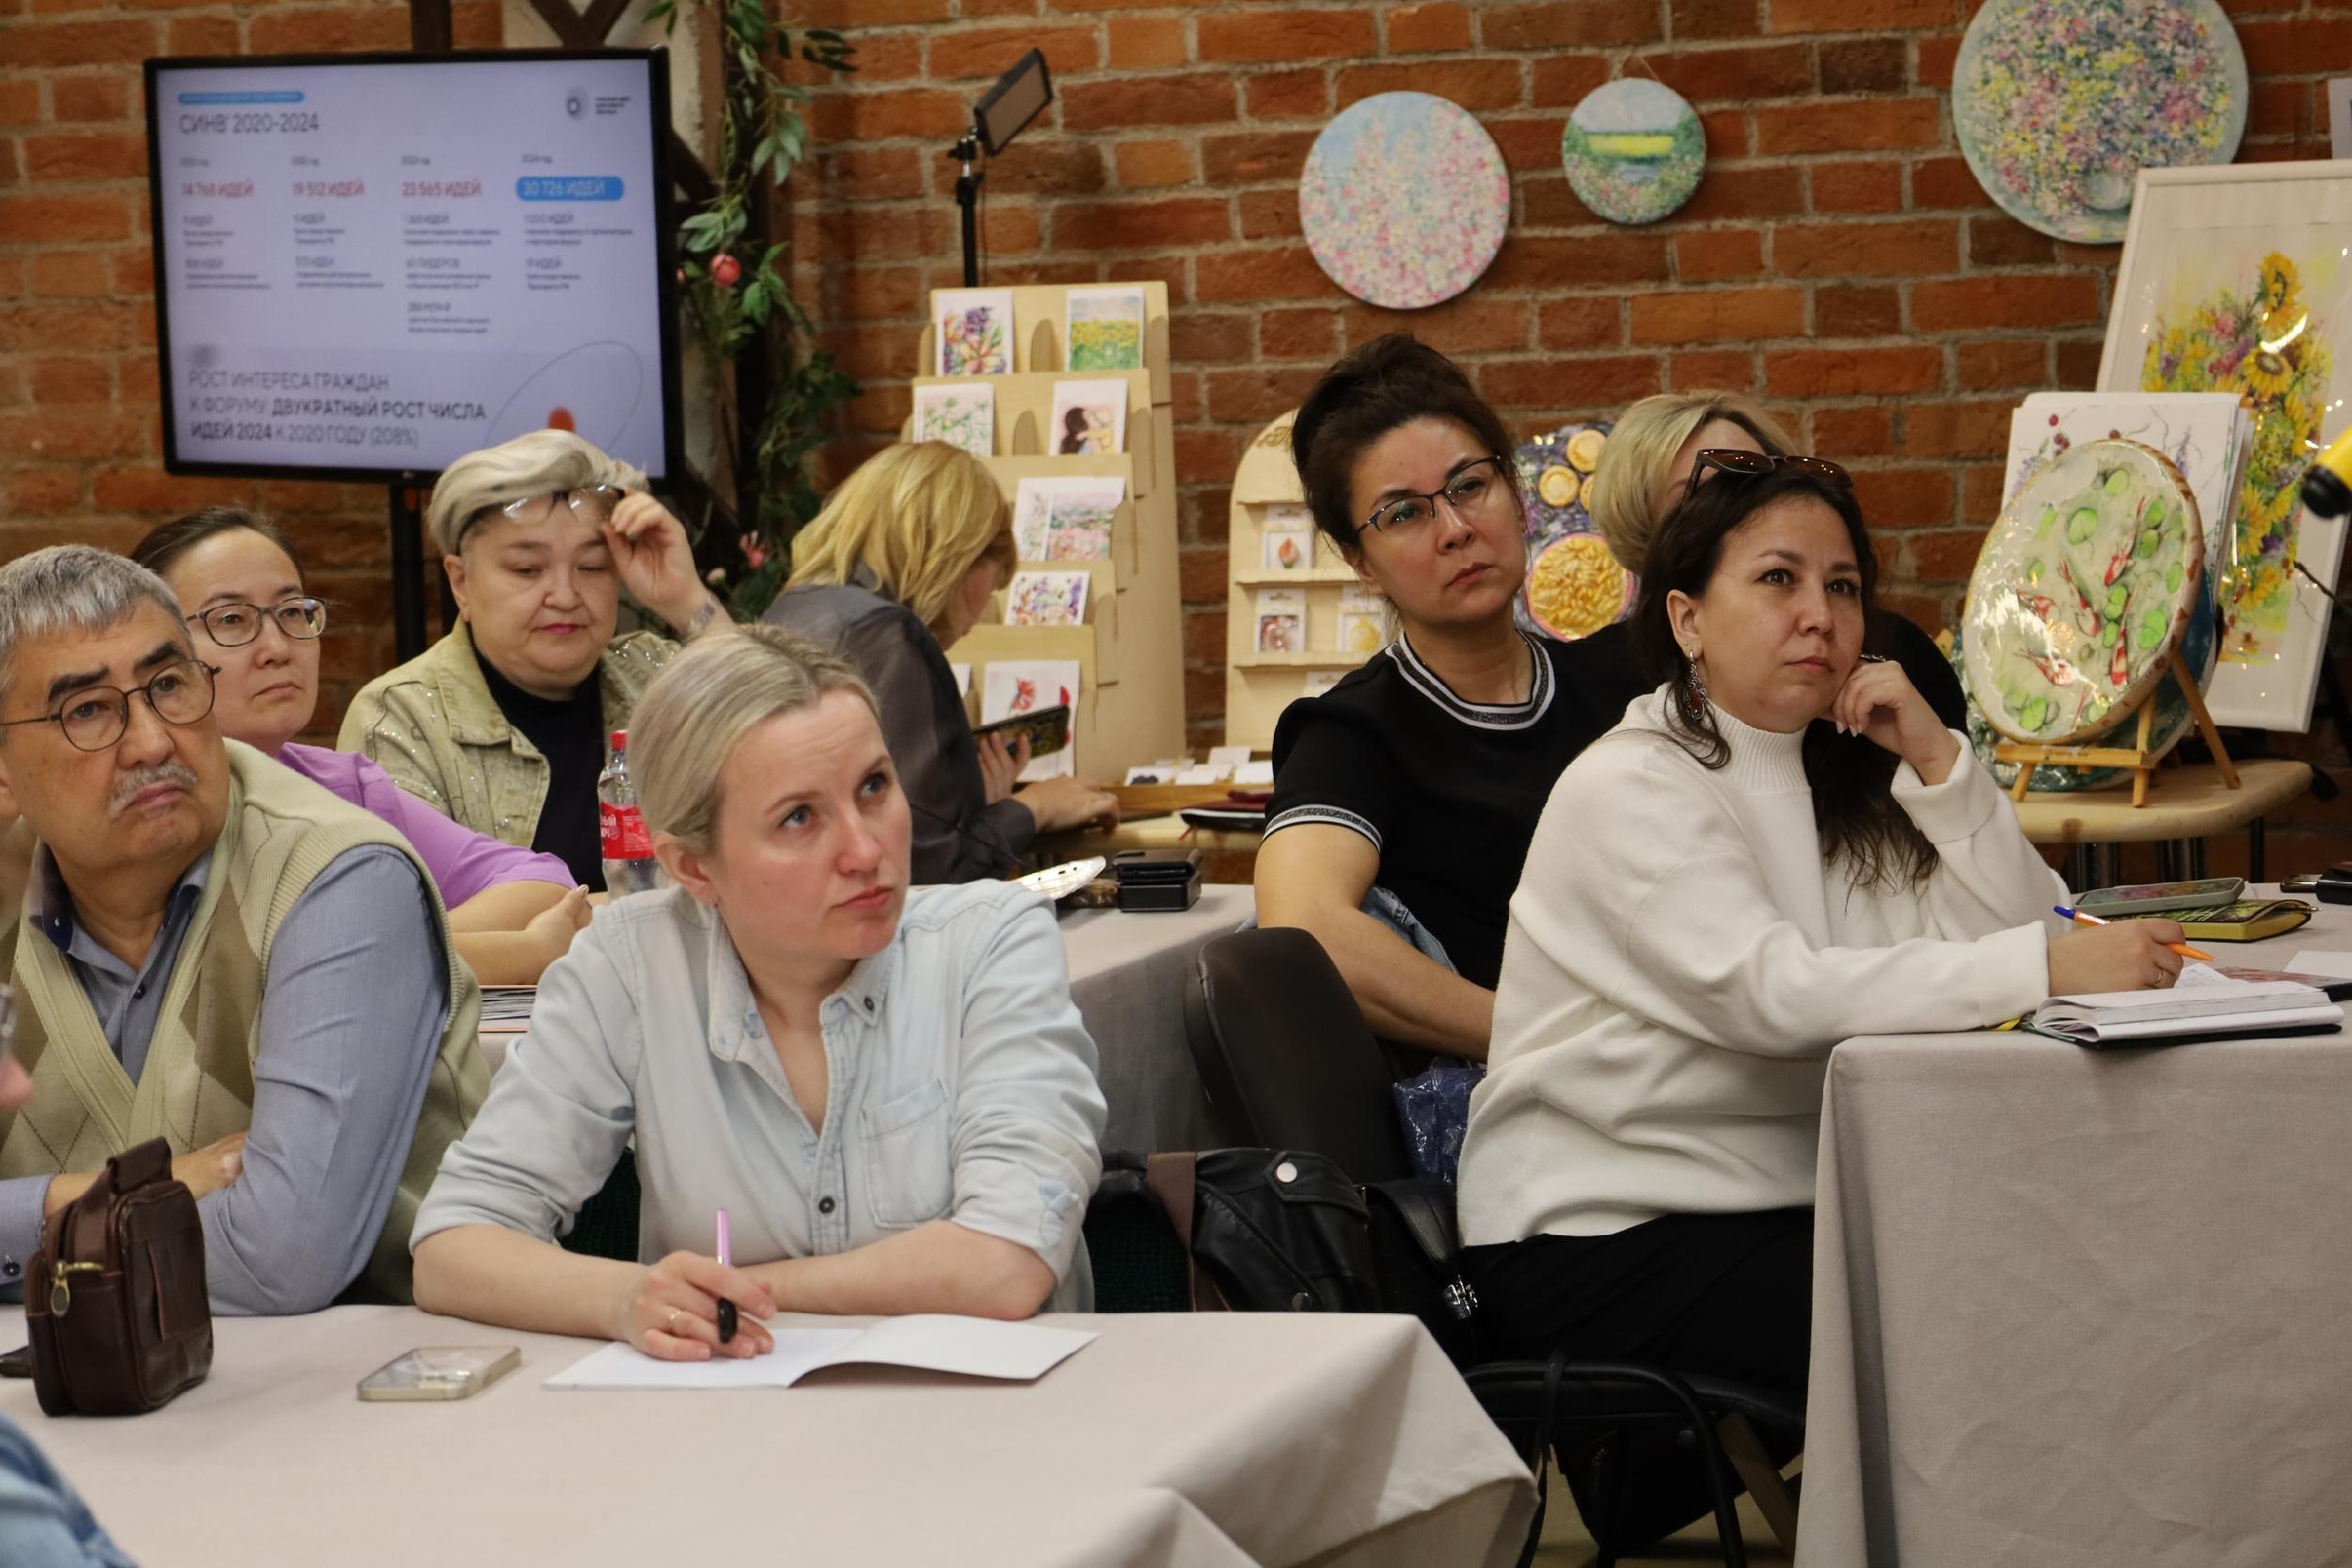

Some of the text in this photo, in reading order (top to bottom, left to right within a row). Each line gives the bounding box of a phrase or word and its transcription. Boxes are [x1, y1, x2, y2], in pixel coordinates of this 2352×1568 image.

[232, 112, 319, 133] 2020-2024
[218, 179, 255, 198] ИДЕЙ
[328, 177, 365, 198] ИДЕЙ
[444, 177, 483, 198] ИДЕЙ
[565, 178, 606, 198] ИДЕЙ
[189, 370, 389, 392] РОСТ ИНТЕРЕСА ГРАЖДАН
[190, 397, 199, 412] К
[272, 396, 378, 417] ДВУКРАТНЫЙ
[382, 402, 424, 419] РОСТ
[428, 403, 486, 420] ЧИСЛА
[191, 418, 232, 440] ИДЕЙ
[237, 421, 272, 440] 2024
[288, 424, 324, 443] 2020
[327, 425, 366, 445] ГОДУ
